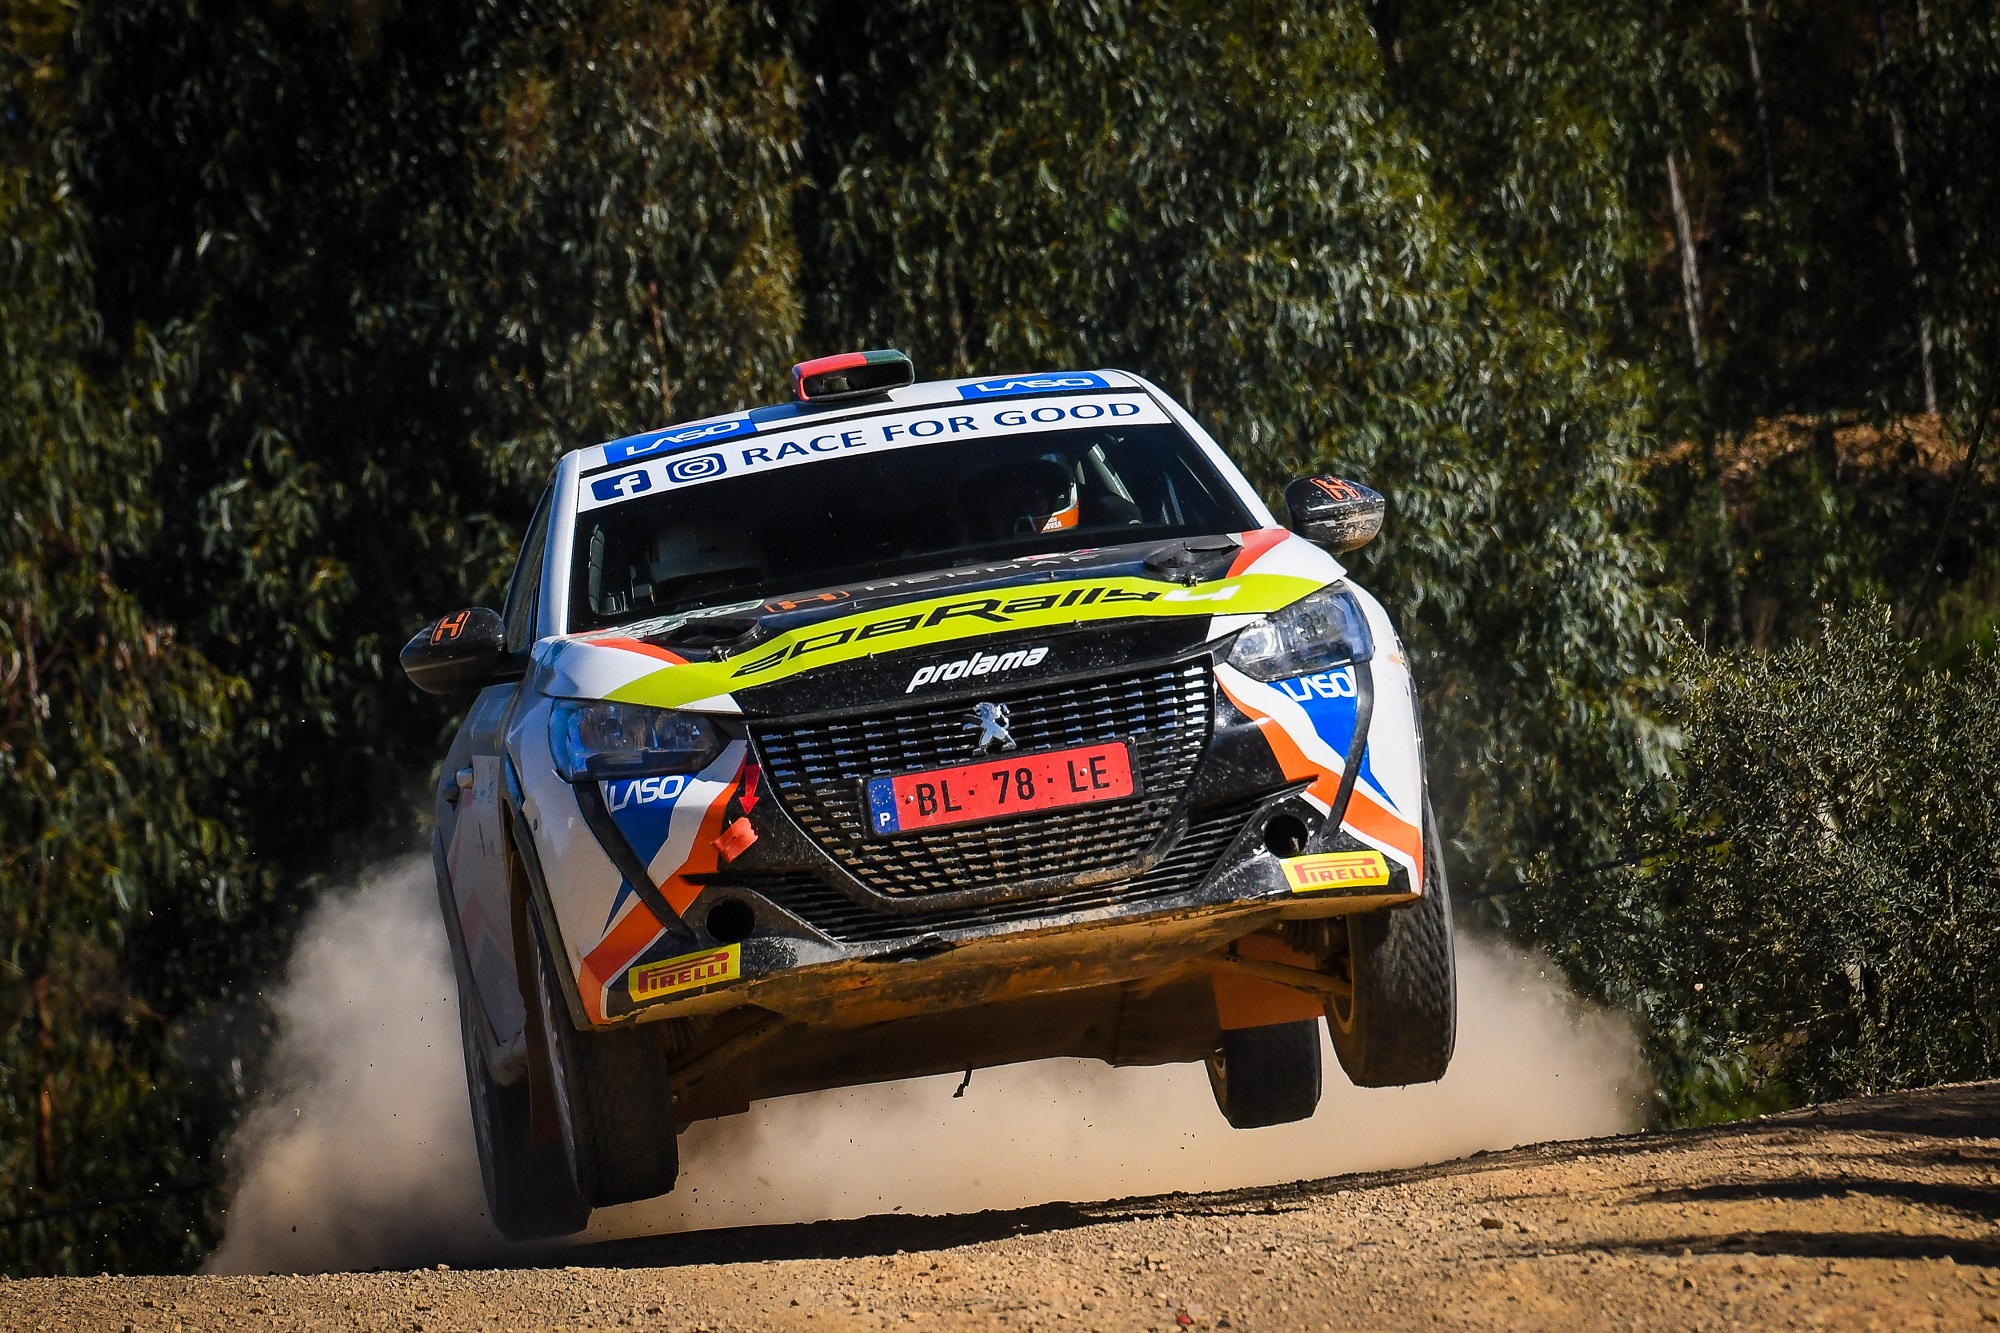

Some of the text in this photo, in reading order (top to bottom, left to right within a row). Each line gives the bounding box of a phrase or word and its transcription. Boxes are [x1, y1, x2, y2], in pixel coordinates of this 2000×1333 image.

[976, 377, 1094, 393] LASO
[625, 421, 740, 457] LASO
[742, 403, 1141, 466] RACE FOR GOOD
[905, 647, 1049, 693] prolama
[1280, 669, 1356, 702] LASO
[607, 775, 686, 812] LASO
[915, 755, 1111, 817] BL 78 LE
[879, 812, 891, 827] P
[1293, 857, 1380, 884] PIRELLI
[638, 952, 730, 994] PIRELLI
